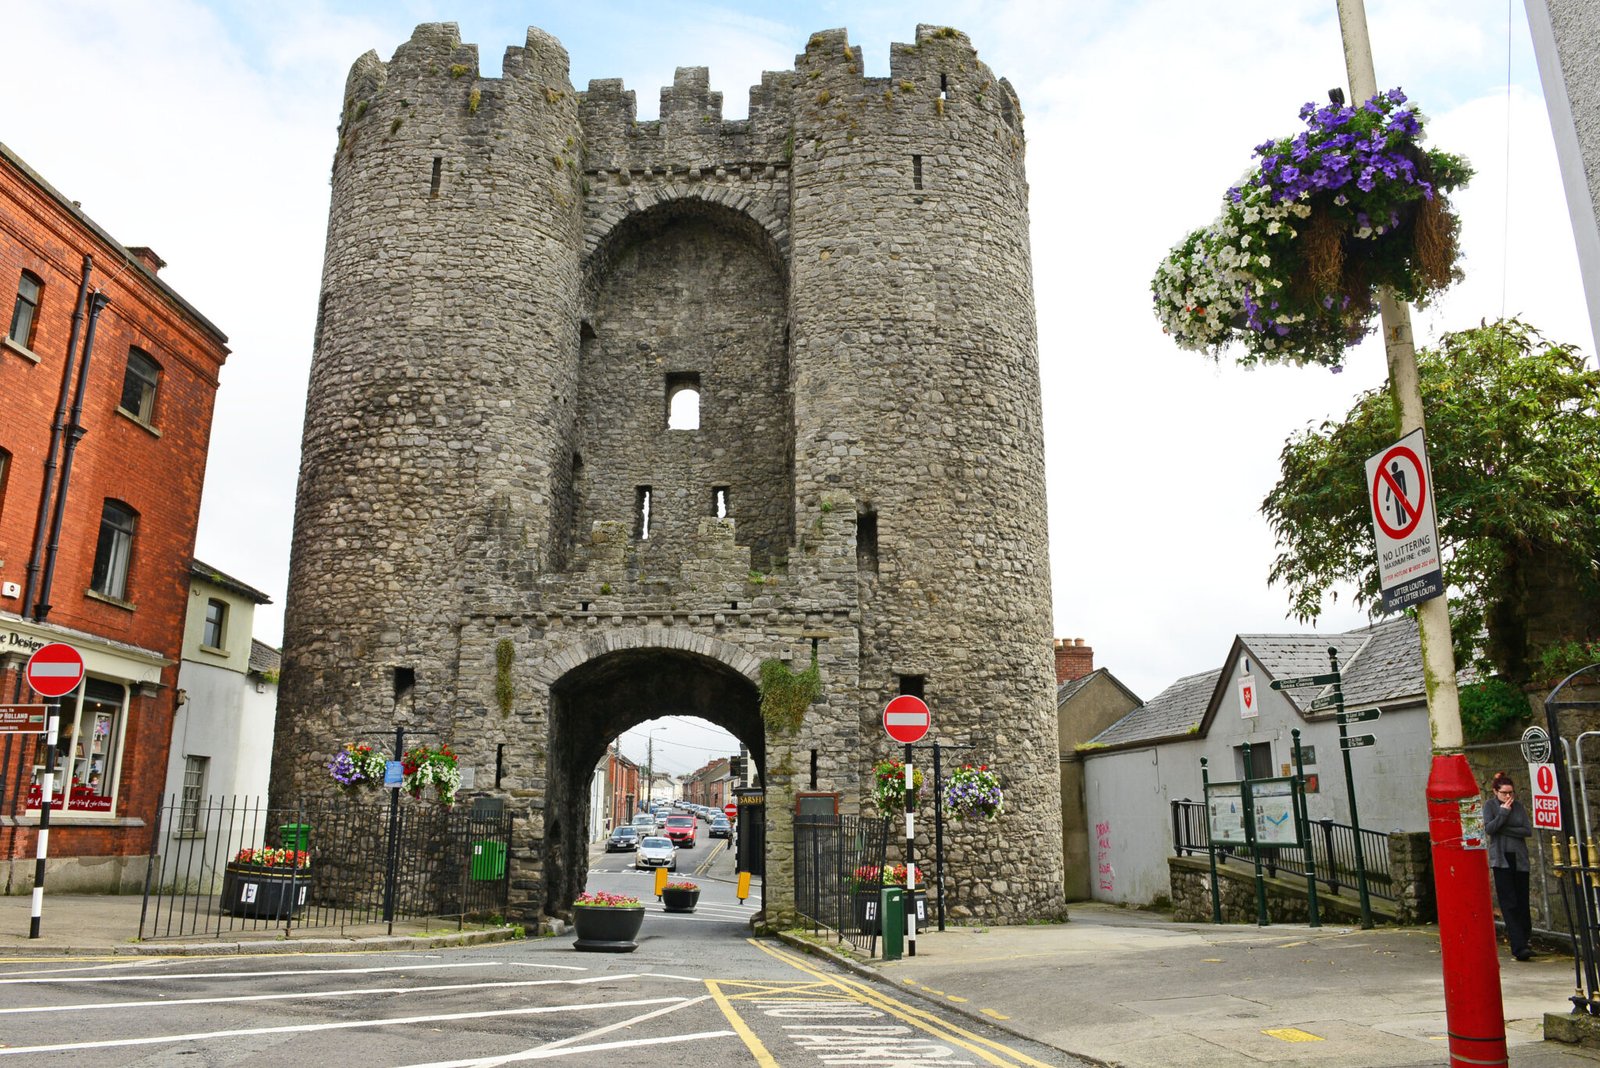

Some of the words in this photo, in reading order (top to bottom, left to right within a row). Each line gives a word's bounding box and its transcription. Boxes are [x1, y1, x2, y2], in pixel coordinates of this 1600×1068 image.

[1383, 551, 1393, 562] NO
[1395, 534, 1430, 558] LITTERING
[1384, 556, 1406, 570] MAXIMUM
[1388, 596, 1404, 607] DON'T
[1403, 590, 1420, 603] LITTER
[1419, 584, 1436, 597] LOUTH
[1394, 585, 1409, 597] LITTER
[1535, 798, 1558, 810] KEEP
[1537, 811, 1557, 823] OUT
